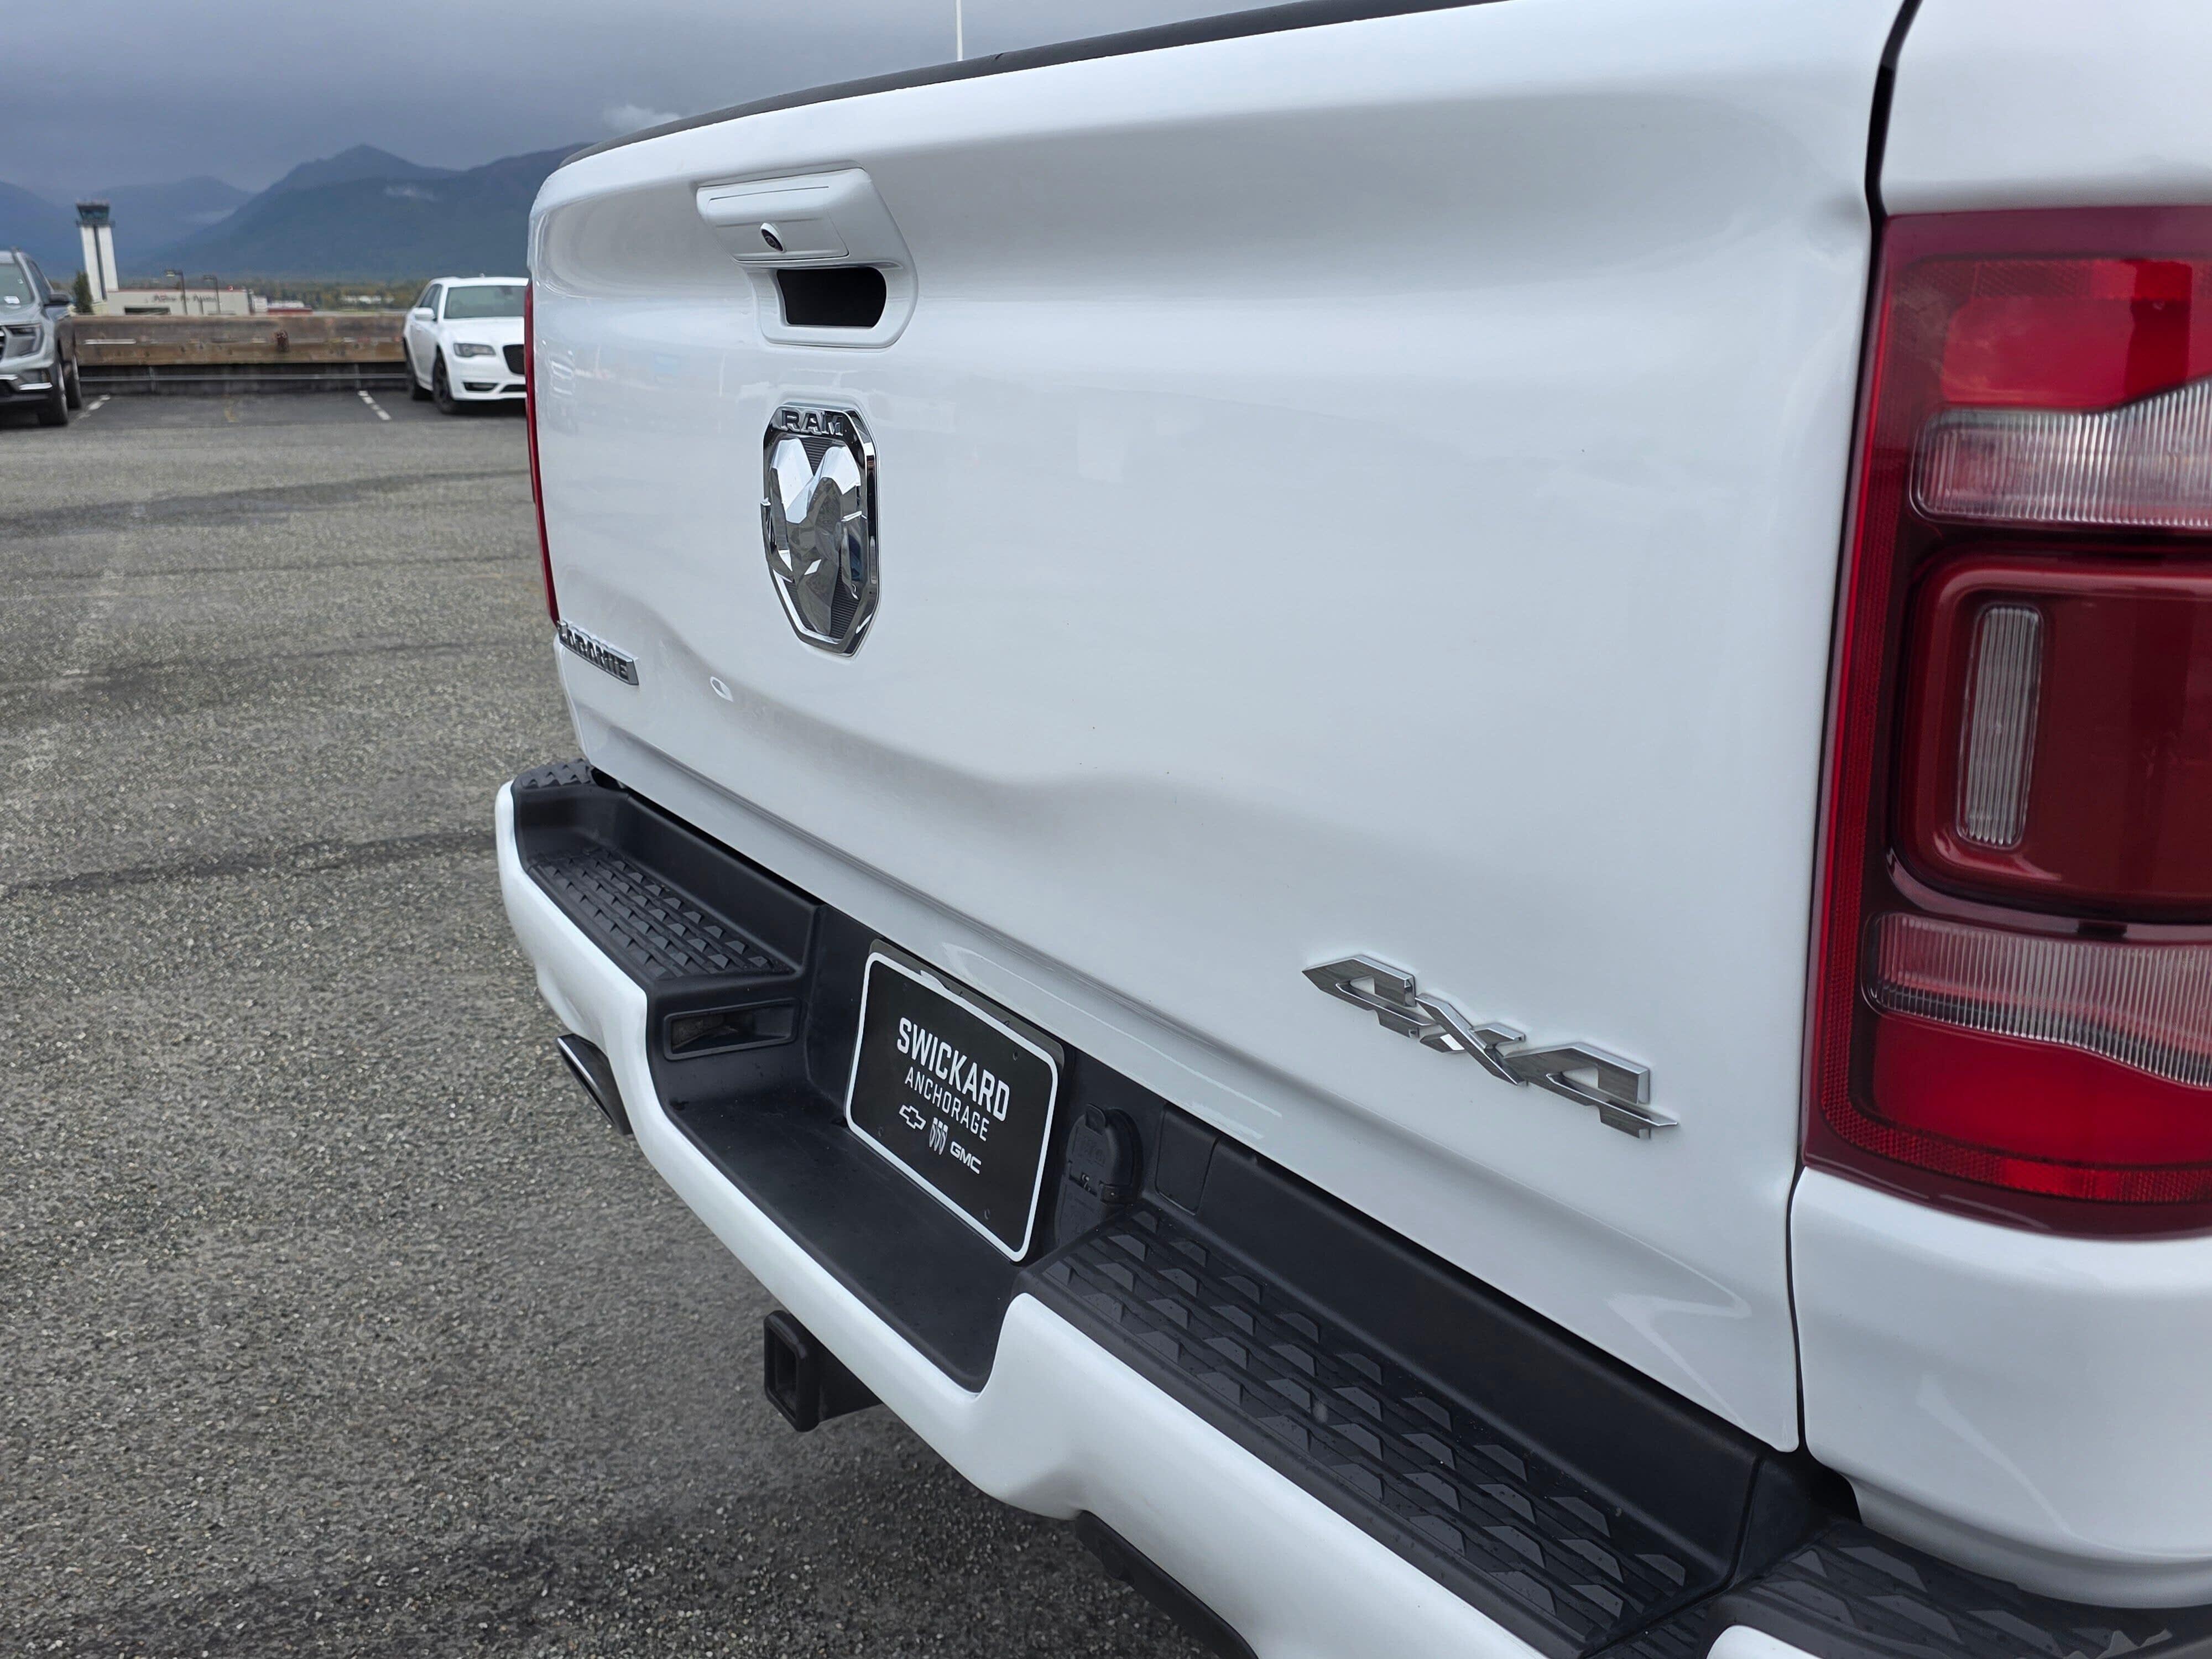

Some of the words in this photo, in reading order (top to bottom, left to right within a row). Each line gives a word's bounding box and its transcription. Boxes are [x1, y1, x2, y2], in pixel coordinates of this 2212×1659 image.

[774, 409, 844, 436] RAM
[897, 1017, 1010, 1121] SWICKARD
[904, 1066, 989, 1141] ANCHORAGE
[950, 1141, 982, 1175] GMC
